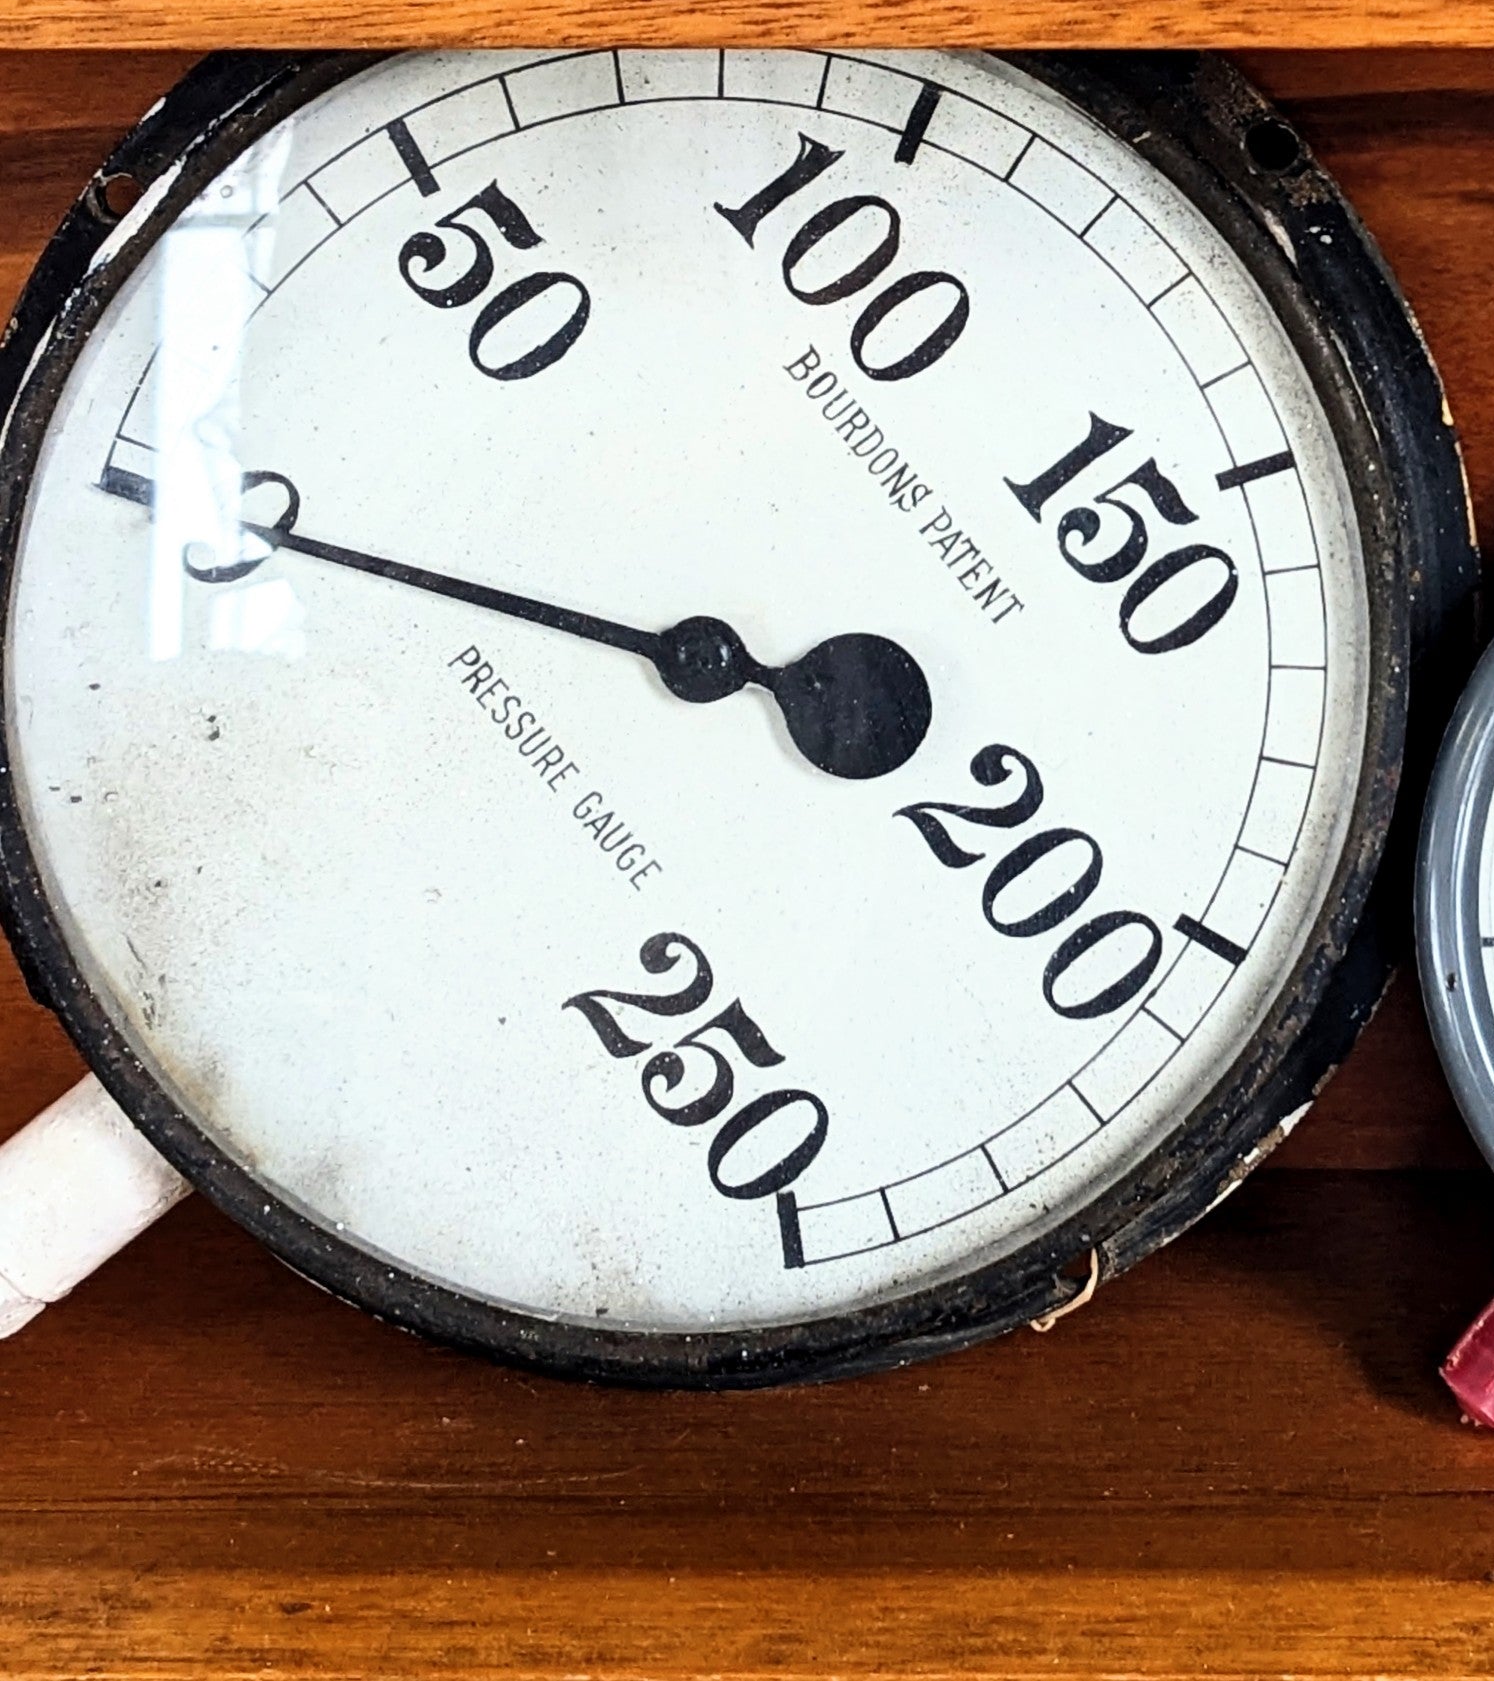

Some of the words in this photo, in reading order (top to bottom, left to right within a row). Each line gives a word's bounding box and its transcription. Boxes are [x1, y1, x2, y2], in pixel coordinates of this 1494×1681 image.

[398, 180, 592, 382] 50
[712, 132, 971, 382] 100
[919, 505, 1025, 624] PATENT
[1003, 410, 1240, 654] 150
[448, 645, 580, 793] PRESSURE
[572, 791, 662, 892] GAUGE
[894, 742, 1163, 1020] 200
[562, 931, 828, 1199] 250
